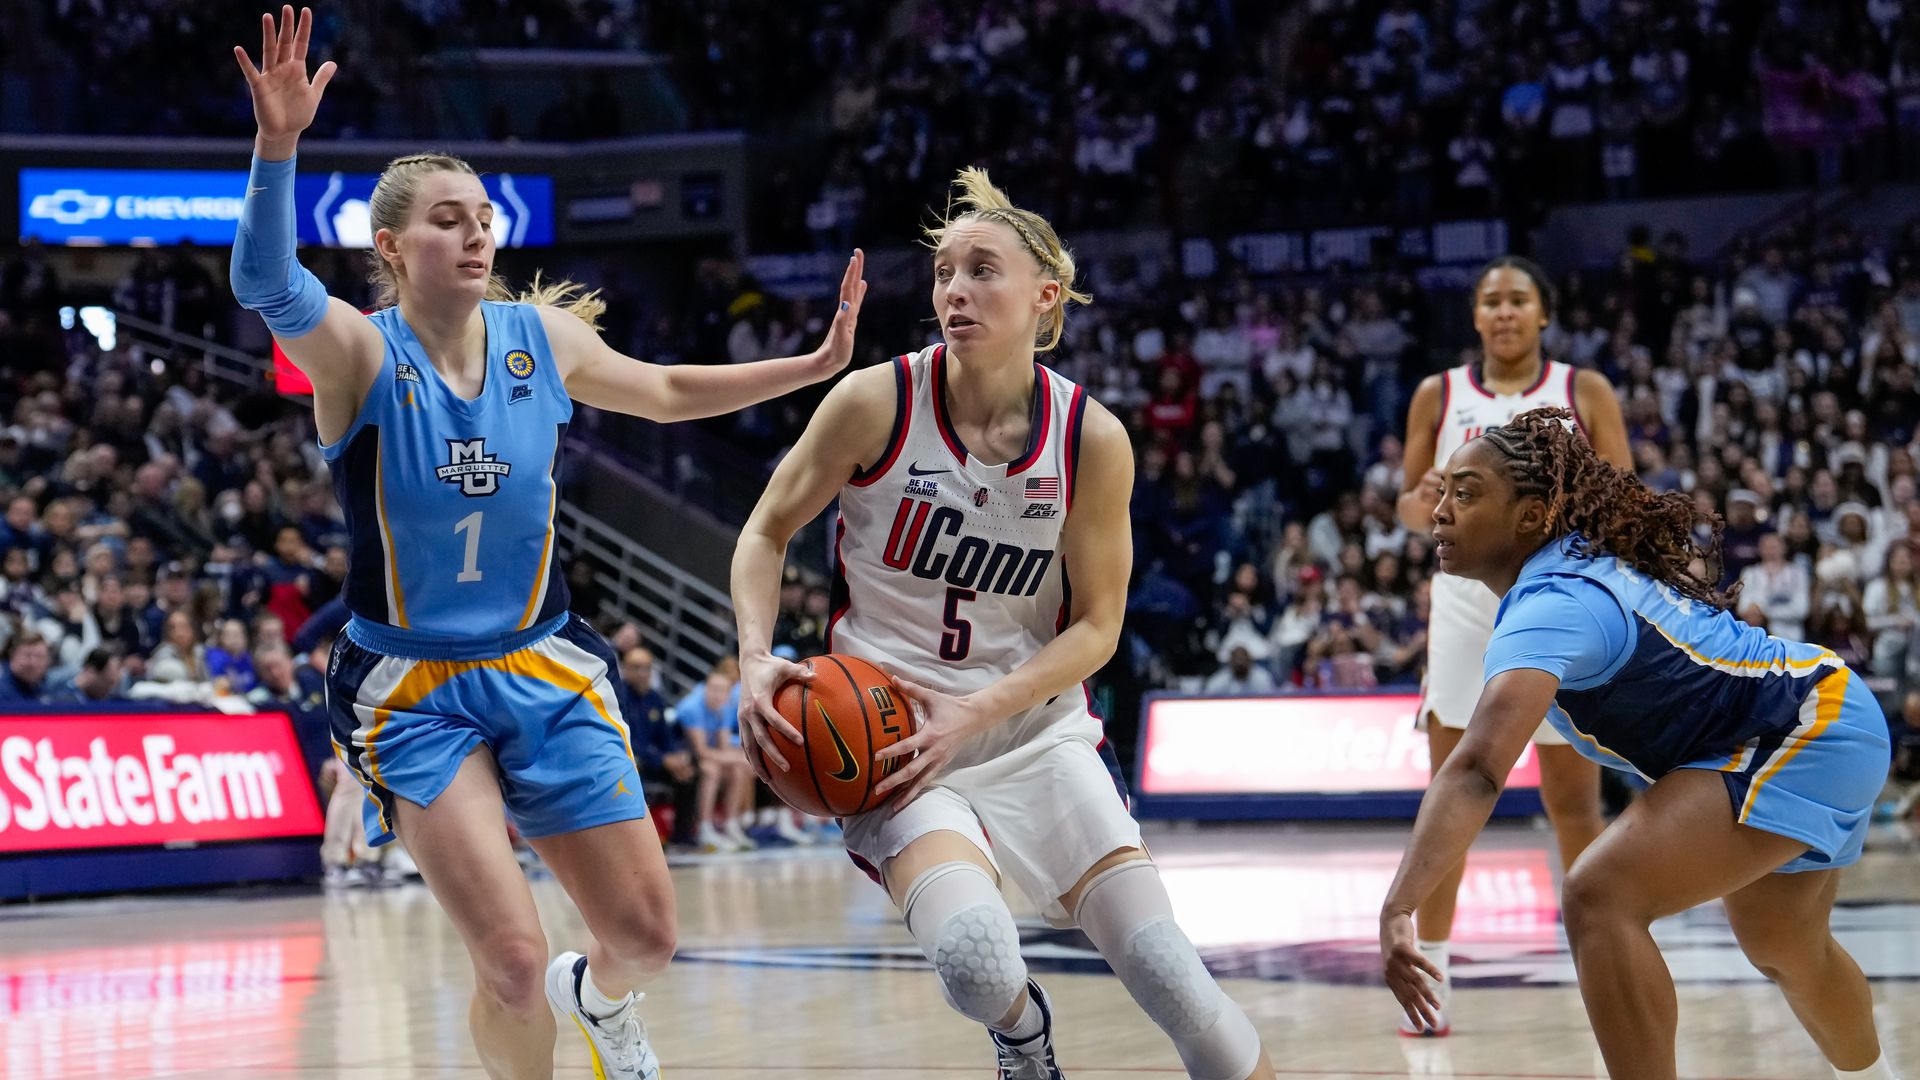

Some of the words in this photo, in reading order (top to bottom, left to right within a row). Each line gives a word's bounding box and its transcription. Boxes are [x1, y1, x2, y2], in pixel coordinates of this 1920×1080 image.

[115, 195, 243, 220] CHEVRO
[397, 364, 408, 373] BE
[441, 464, 506, 476] MARQUETTE
[909, 479, 921, 487] BE
[922, 480, 938, 490] THE
[904, 486, 938, 497] CHANGE
[1028, 503, 1053, 511] BIG
[454, 511, 483, 583] 1
[883, 497, 1054, 597] UConn
[939, 586, 976, 661] 5
